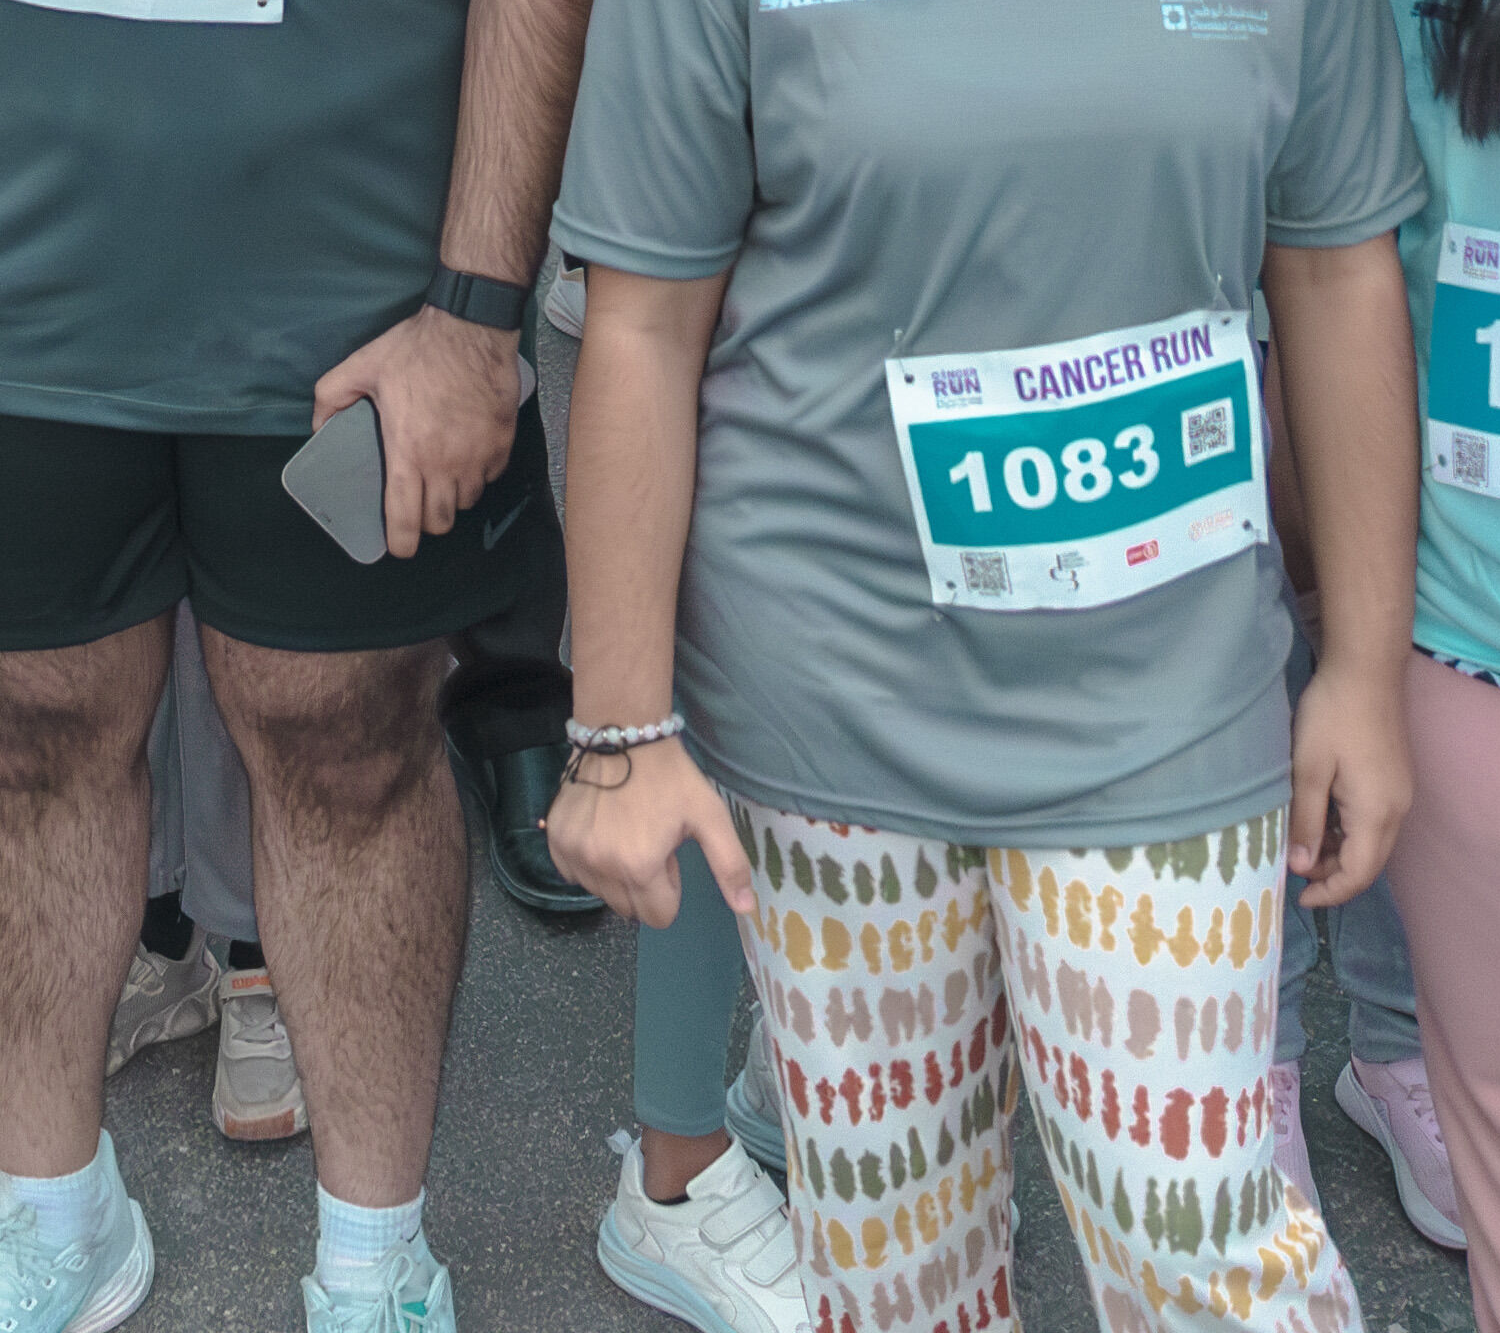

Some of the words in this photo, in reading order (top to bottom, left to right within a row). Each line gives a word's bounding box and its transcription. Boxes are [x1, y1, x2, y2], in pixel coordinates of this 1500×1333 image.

[1463, 244, 1500, 270] RUN
[932, 376, 982, 397] RUN
[1014, 342, 1147, 403] CANCER
[1150, 323, 1214, 374] RUN
[949, 423, 1161, 513] 1083
